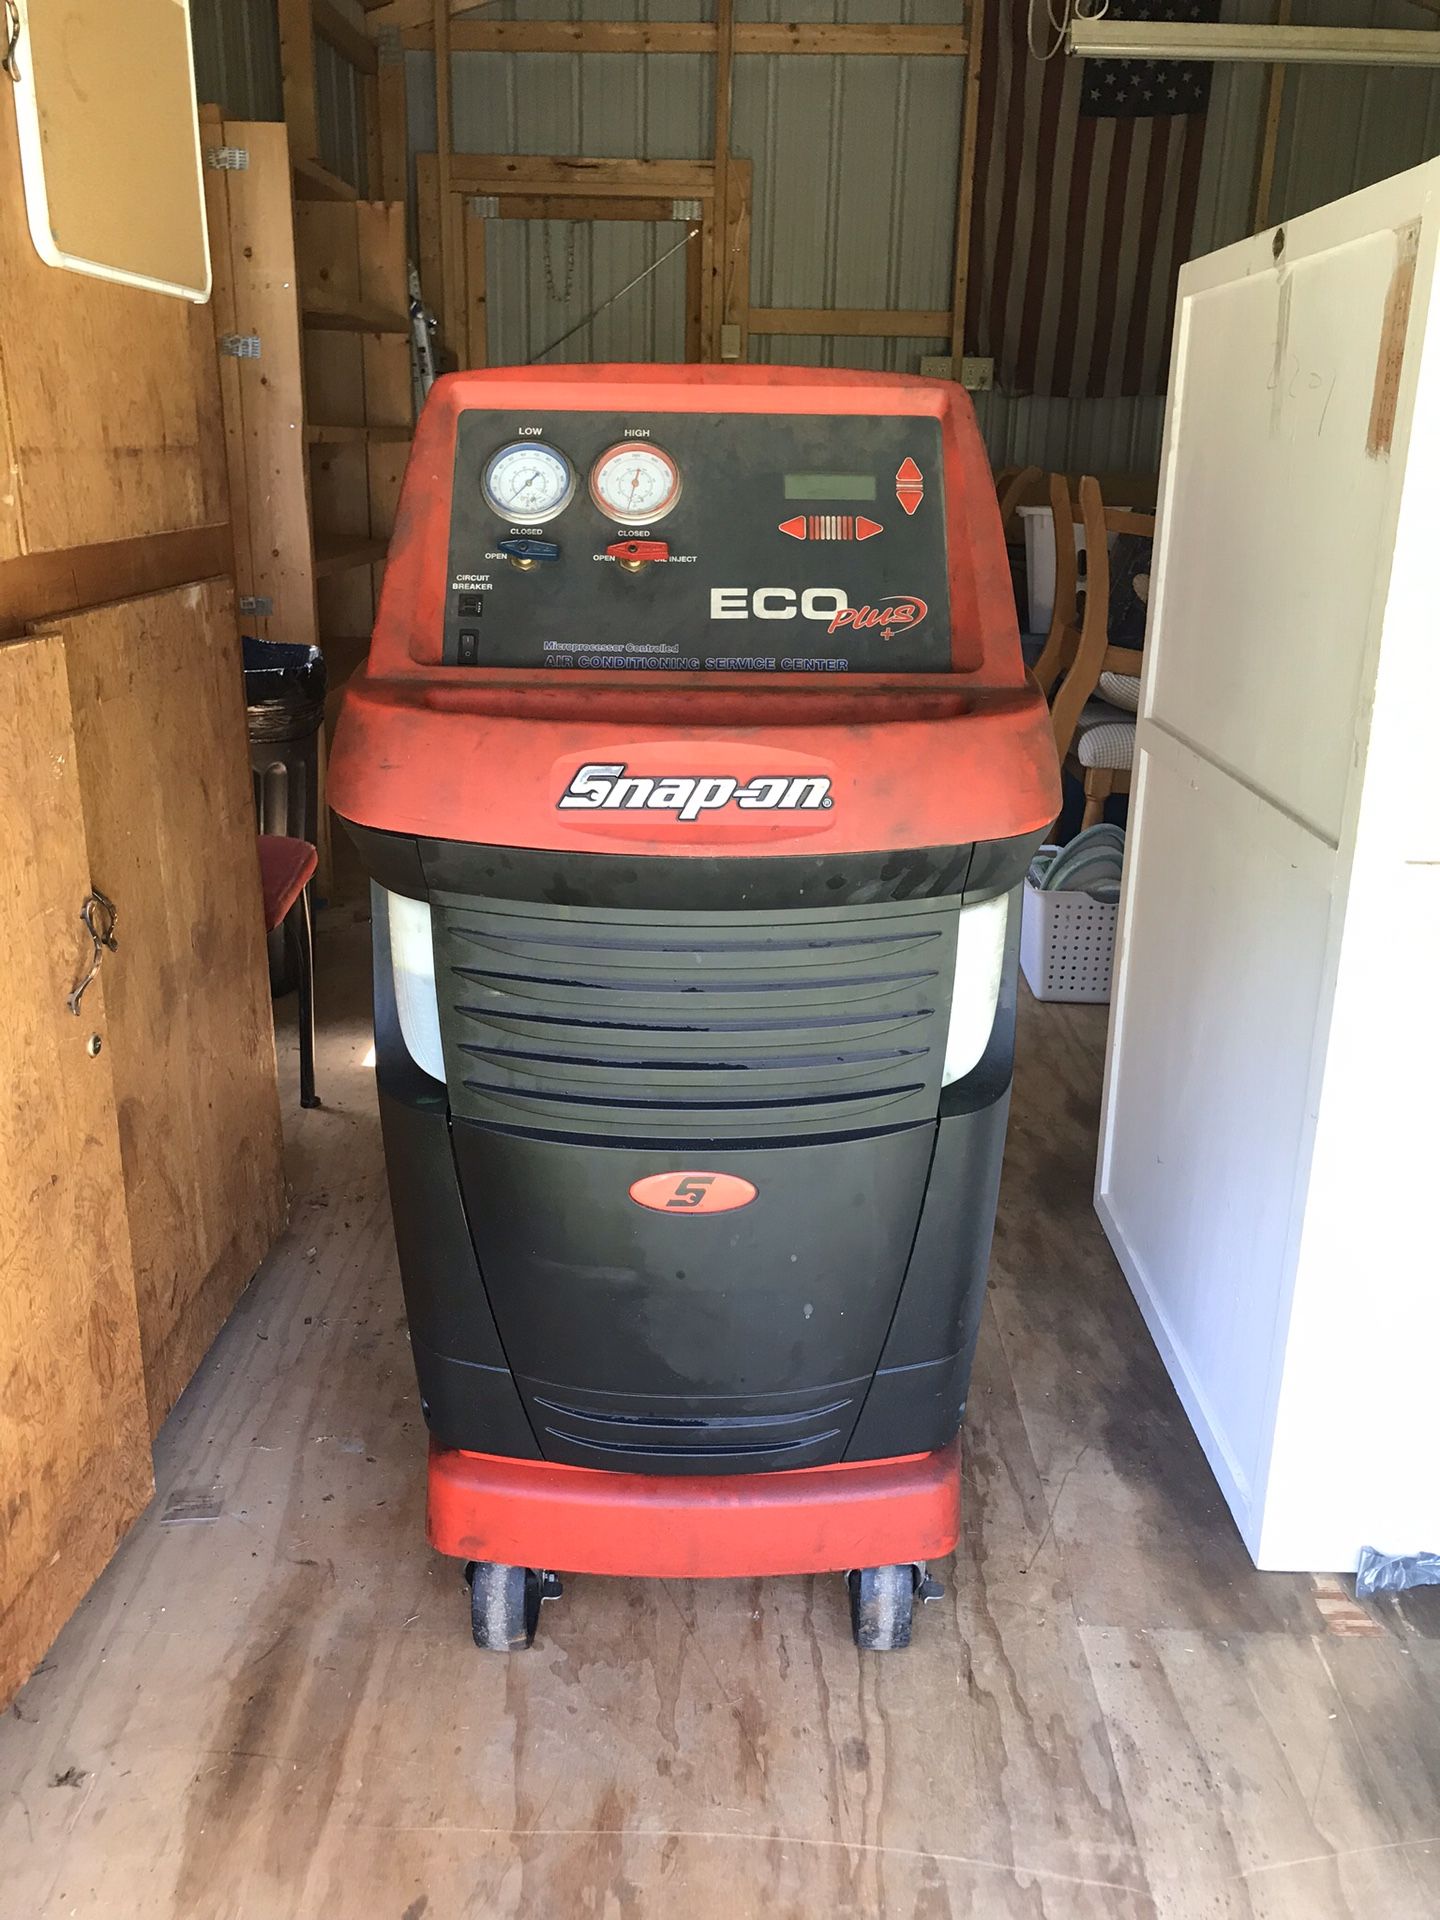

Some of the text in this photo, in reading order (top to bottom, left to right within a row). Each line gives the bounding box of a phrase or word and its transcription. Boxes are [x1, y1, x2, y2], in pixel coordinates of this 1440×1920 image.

[518, 427, 543, 435] LOW
[624, 429, 650, 437] HIGH
[484, 552, 508, 560] OPEN
[592, 554, 616, 562] OPEN
[710, 587, 849, 620] ECO
[625, 643, 679, 653] Controlled
[544, 655, 849, 671] AIR CONDITIONING SERVICE CENTER
